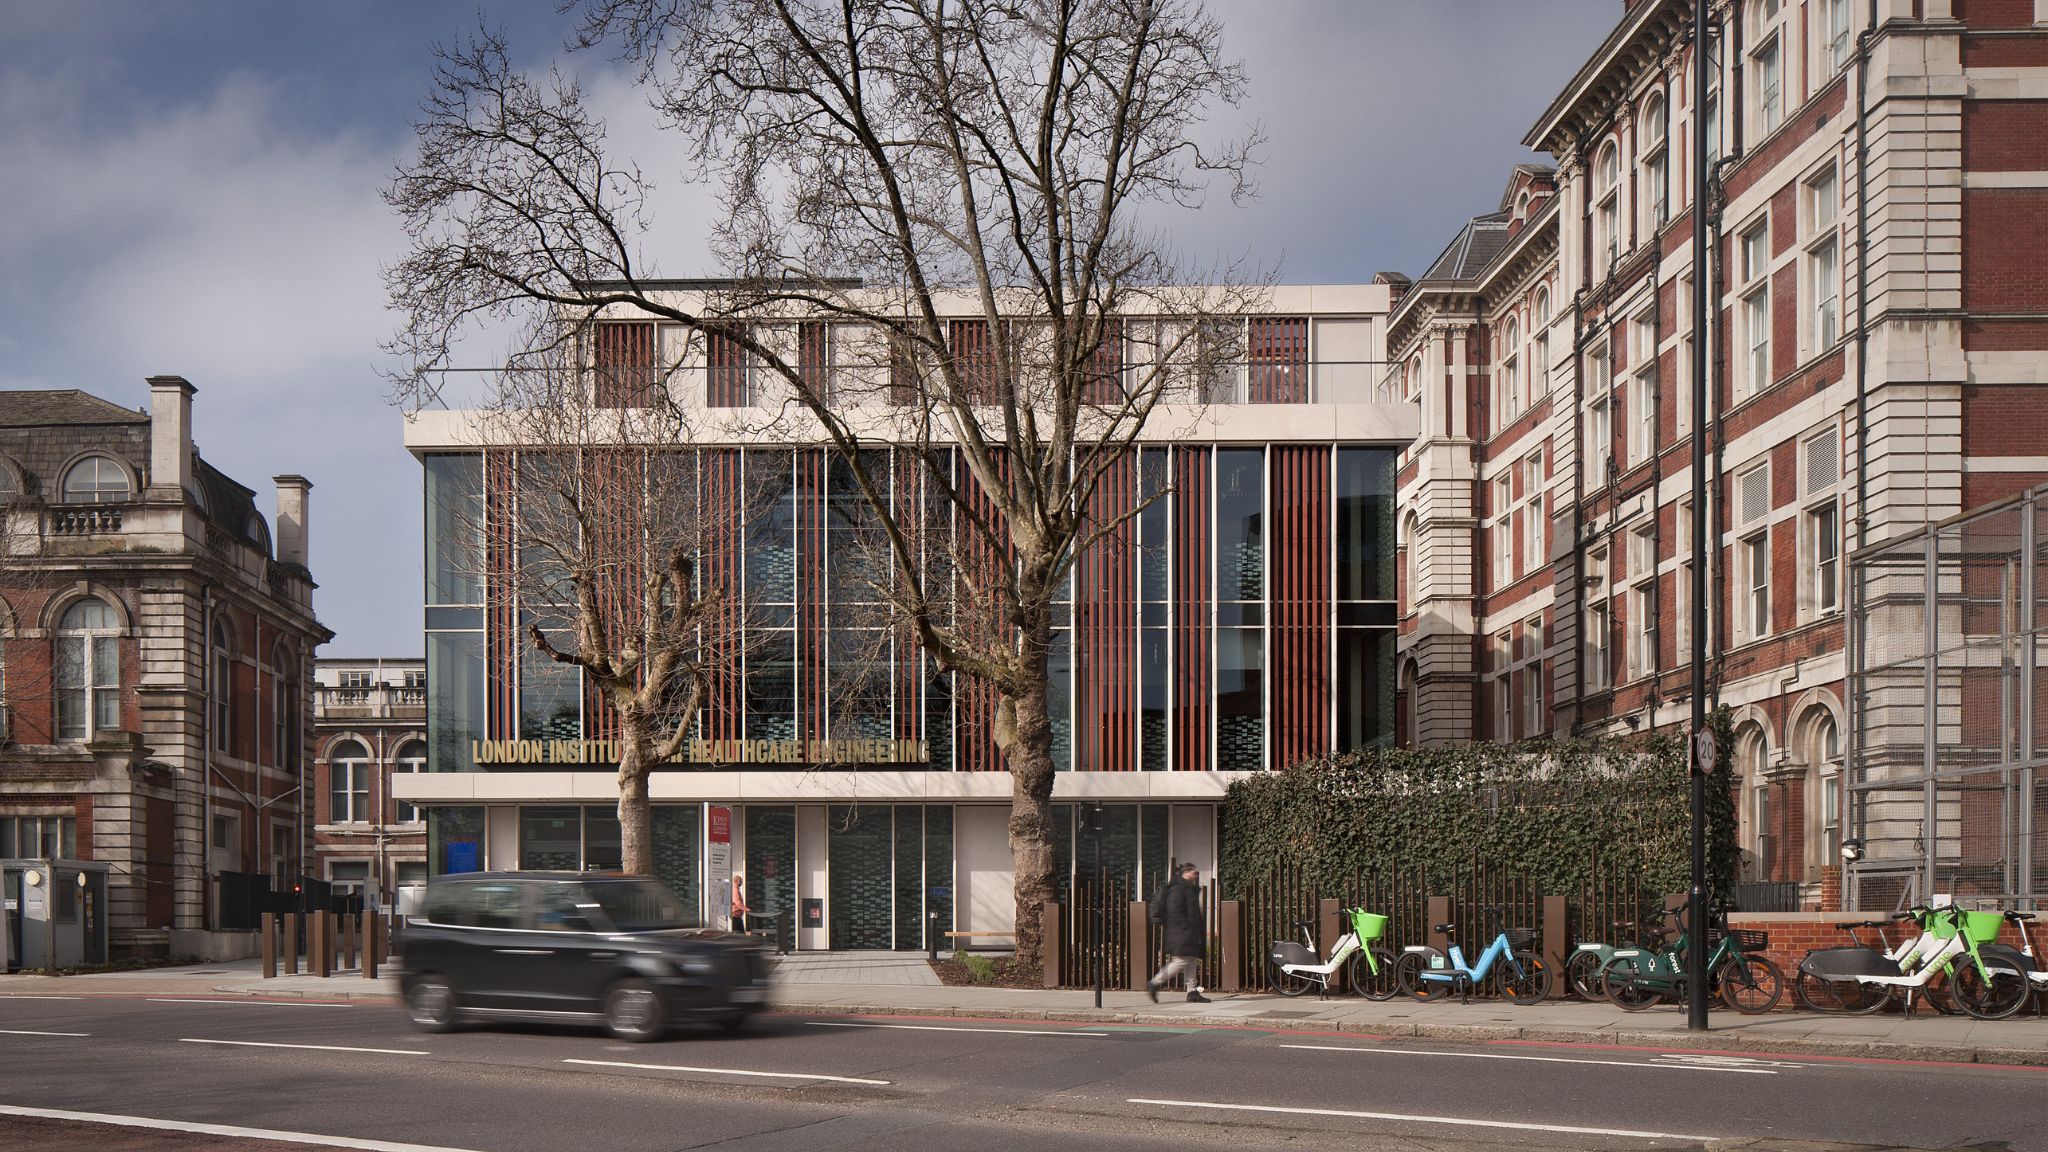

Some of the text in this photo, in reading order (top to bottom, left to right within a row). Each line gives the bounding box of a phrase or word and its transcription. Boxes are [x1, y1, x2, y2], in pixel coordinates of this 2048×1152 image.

[472, 739, 543, 763] LONDON
[550, 739, 622, 763] INSTITU
[688, 738, 804, 763] HEALTHCARE
[809, 739, 930, 763] ENGINEERING
[1700, 740, 1714, 761] 20
[1668, 952, 1681, 974] forest
